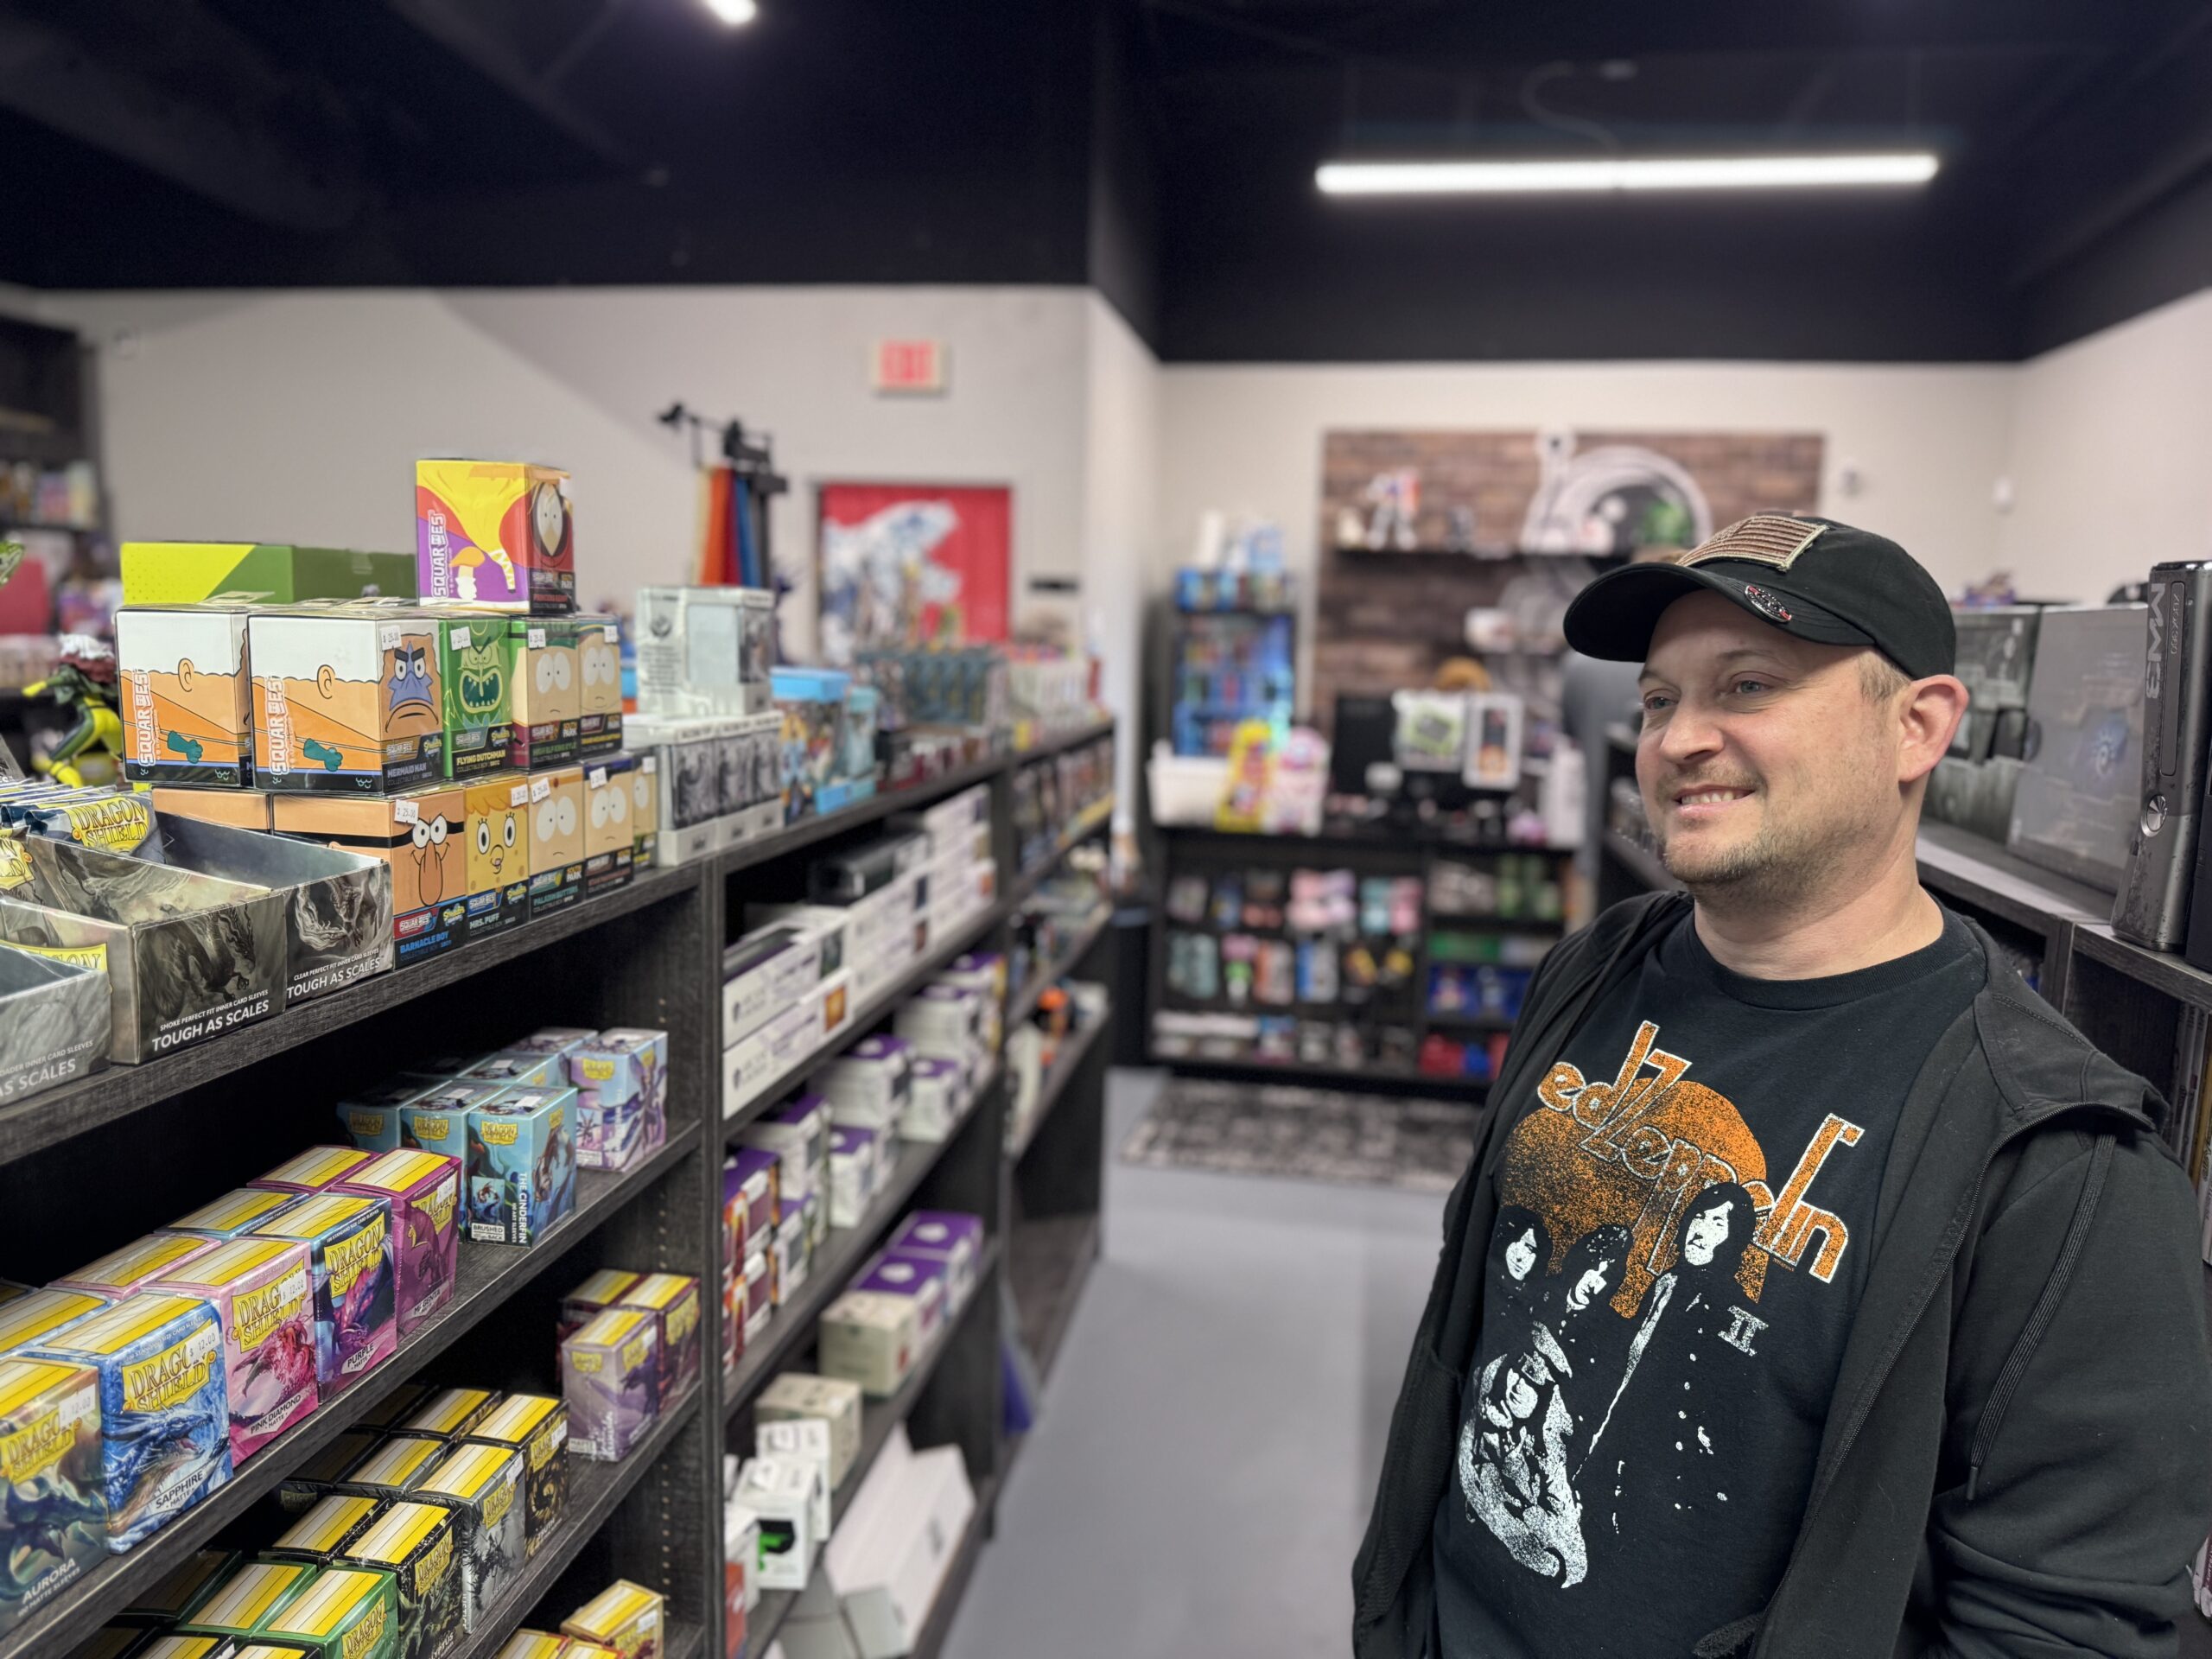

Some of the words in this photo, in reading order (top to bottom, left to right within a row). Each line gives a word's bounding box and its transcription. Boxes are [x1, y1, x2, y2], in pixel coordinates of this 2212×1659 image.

[2145, 582, 2166, 699] MW3
[387, 766, 415, 779] MERMAID
[414, 761, 427, 773] MAN
[456, 756, 477, 766] FLYING
[477, 749, 506, 761] DUTCHMAN
[75, 798, 146, 830] DRAGON
[86, 821, 147, 848] SHIELD
[469, 919, 486, 930] MRS.
[485, 912, 499, 925] PUFF
[400, 936, 436, 954] BARNACLE
[435, 931, 448, 943] BOY
[286, 978, 327, 1000] TOUGH
[329, 971, 344, 986] AS
[346, 957, 380, 980] SCALES
[294, 970, 309, 982] CLEAR
[309, 965, 329, 976] PERFECT
[337, 957, 351, 967] INNER
[351, 953, 363, 963] CARD
[362, 948, 379, 960] SLEEVES
[151, 1023, 203, 1052] TOUGH
[205, 1016, 224, 1033] AS
[225, 999, 270, 1027] SCALES
[160, 1018, 181, 1033] SMOKE
[181, 1011, 206, 1026] PERFECT
[206, 1007, 216, 1016] FIT
[215, 1001, 233, 1014] INNER
[232, 997, 248, 1008] CARD
[247, 988, 269, 1002] SLEEVES
[25, 1056, 47, 1069] INNER
[48, 1049, 67, 1061] CARD
[67, 1039, 93, 1054] SLEEVES
[19, 1058, 76, 1090] SCALES
[519, 1172, 528, 1191] THE
[473, 1224, 504, 1234] BRUSHED
[518, 1194, 528, 1244] CINDERFIN
[329, 1221, 382, 1275] DRAGON
[288, 1279, 304, 1296] 12.00
[198, 1332, 216, 1351] 12.00
[347, 1342, 374, 1368] PURPLE
[353, 1354, 369, 1370] MATTE
[137, 1362, 207, 1412] SHIELD
[70, 1396, 91, 1418] 12.00
[250, 1415, 268, 1434] PINK
[268, 1394, 302, 1421] DIAMOND
[268, 1415, 285, 1429] MATTE
[156, 1470, 204, 1510] SAPPHIRE
[170, 1491, 192, 1508] MATTE
[22, 1556, 76, 1605] AURORA
[29, 1586, 54, 1610] MATTE
[53, 1567, 81, 1593] SLEEVES
[346, 1600, 384, 1653] DRAGON
